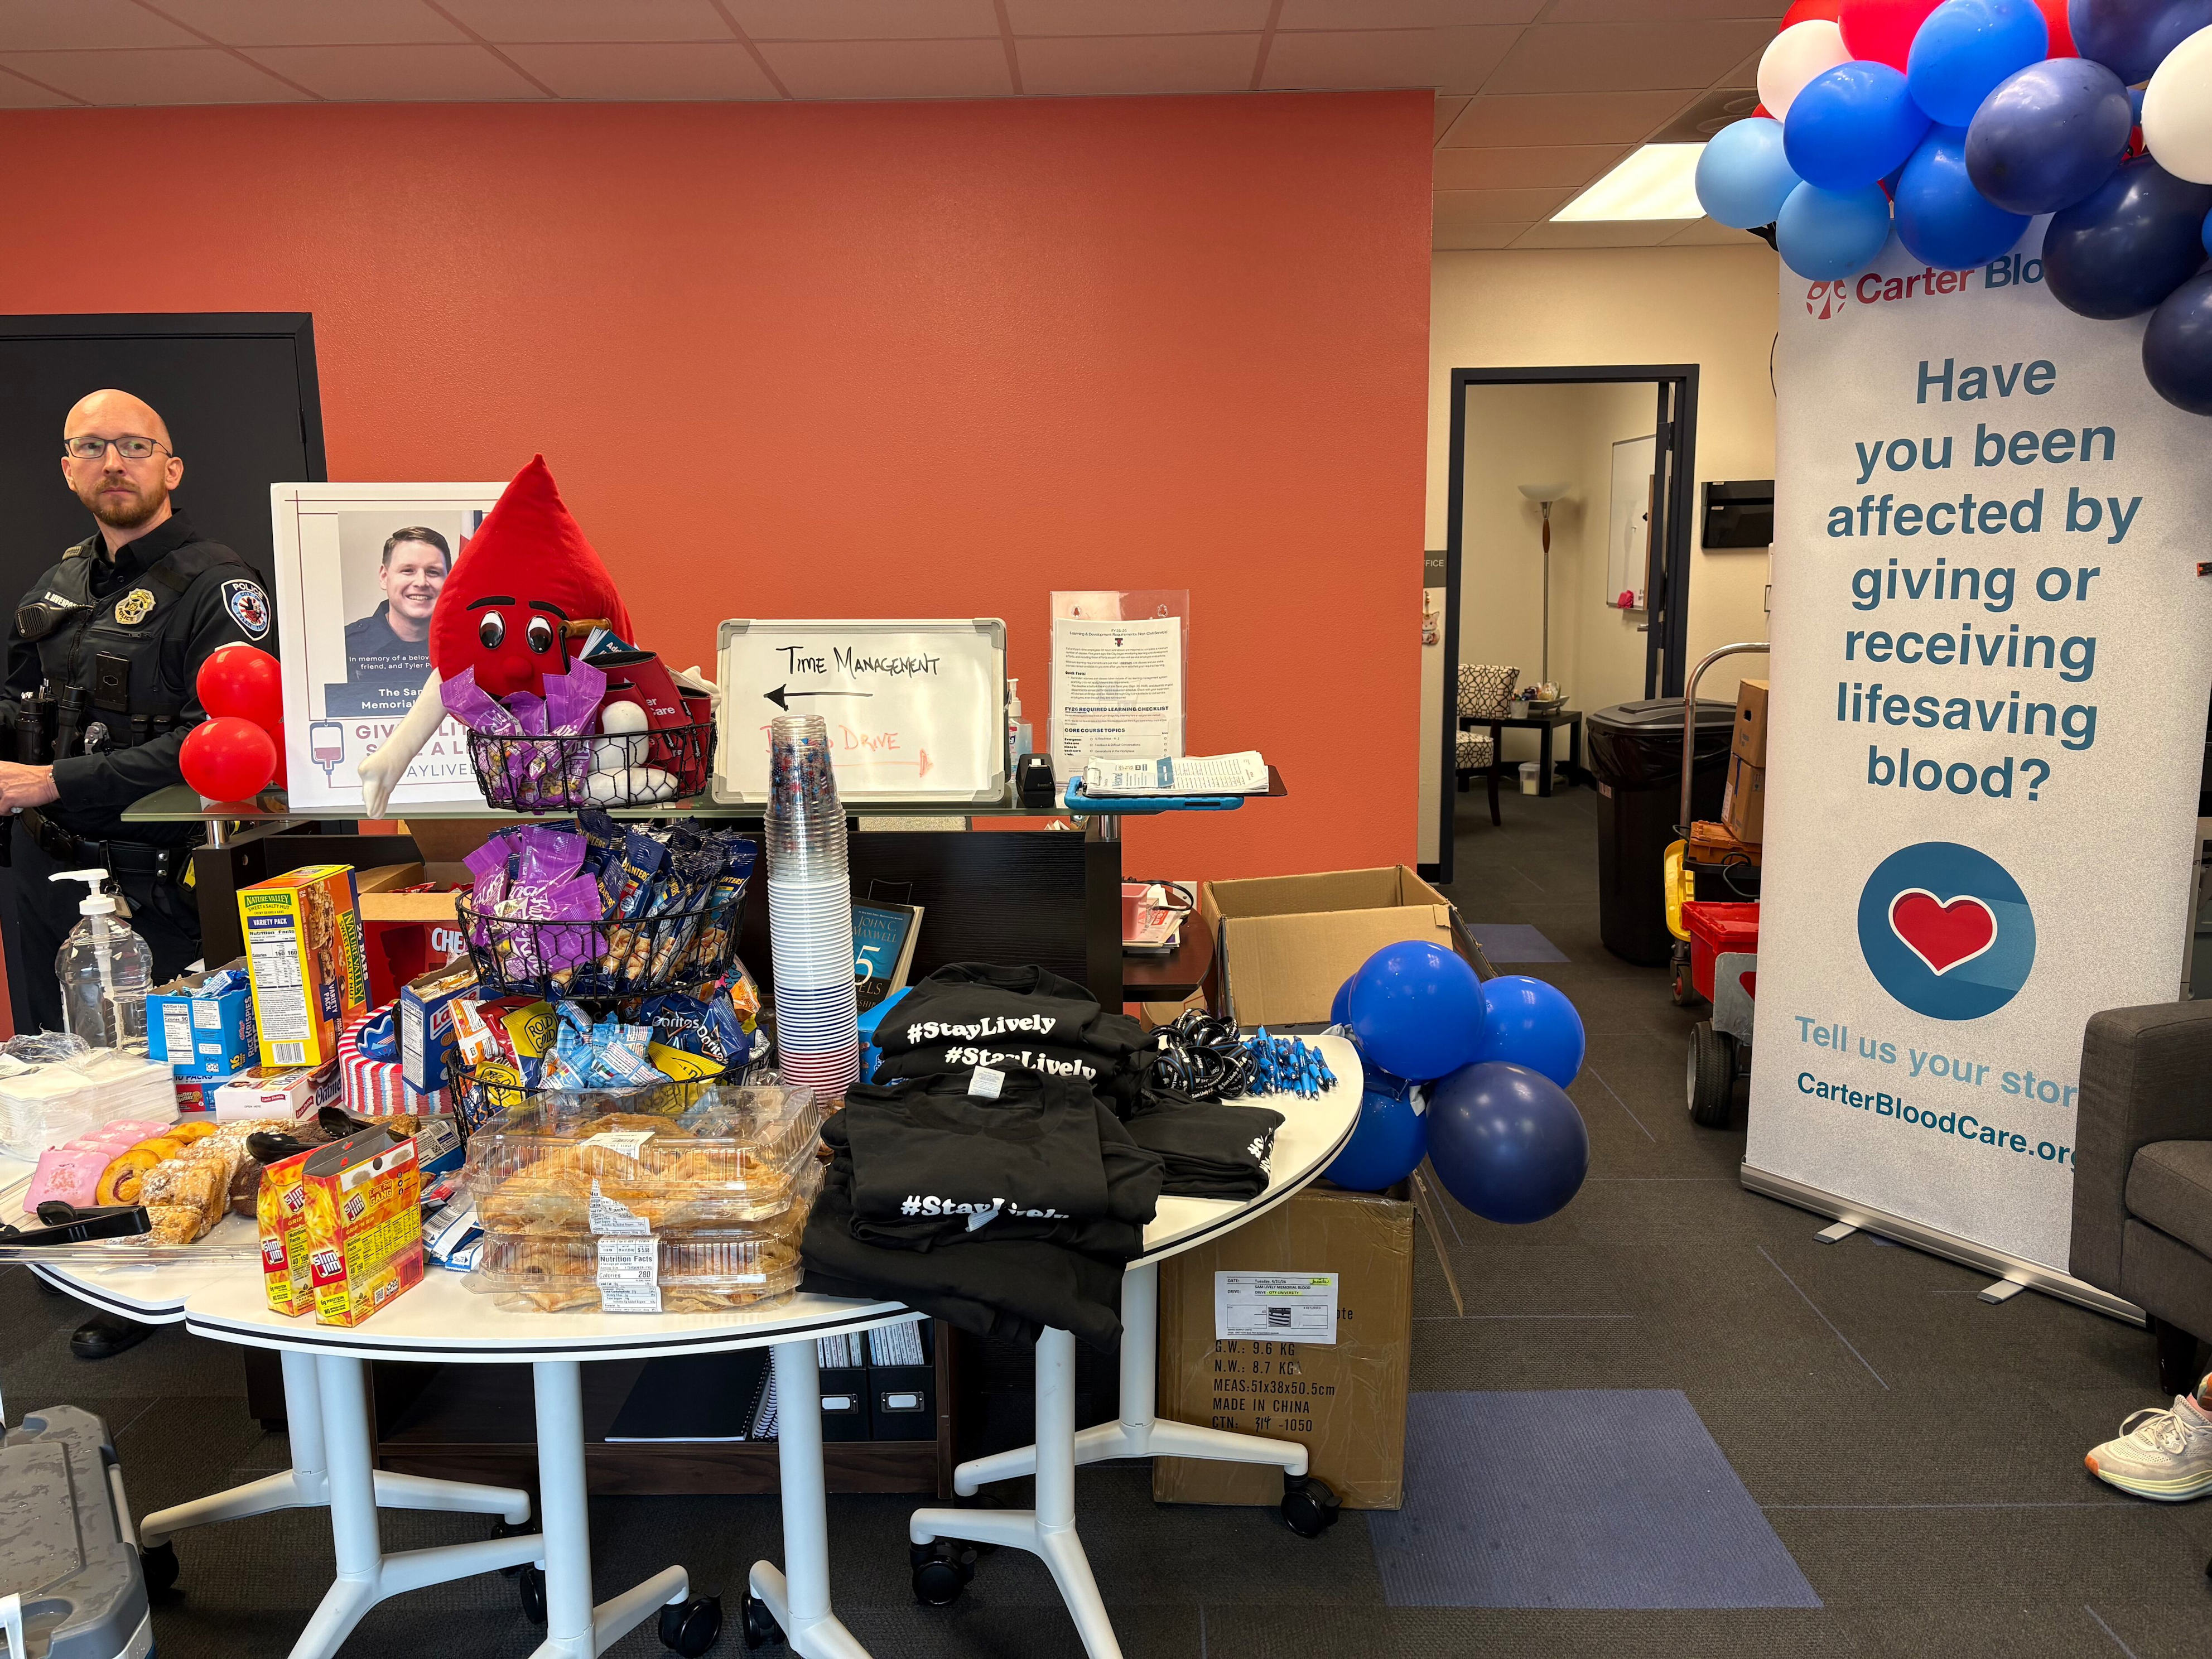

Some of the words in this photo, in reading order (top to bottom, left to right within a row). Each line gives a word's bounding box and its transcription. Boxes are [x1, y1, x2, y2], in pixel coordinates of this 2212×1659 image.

[1856, 267, 1975, 305] Carter
[1917, 358, 2057, 404] Have
[1855, 436, 1953, 484] you
[1974, 423, 2116, 466] been
[1827, 488, 2044, 537] affected
[2065, 487, 2143, 544] by
[232, 583, 263, 600] POLICE
[1852, 558, 2016, 613] giving
[2036, 565, 2100, 602] or
[1846, 623, 2096, 682] receiving
[1837, 682, 2097, 750] lifesaving
[431, 741, 445, 755] A
[1868, 745, 2051, 801] blood?
[621, 857, 649, 881] PLANTERS
[247, 895, 268, 906] NATURE
[268, 895, 288, 904] VALLEY
[599, 882, 616, 906] PLANTERS
[356, 923, 363, 940] 24
[858, 916, 885, 929] JOHN
[888, 921, 897, 931] C.
[339, 920, 349, 948] SWEET
[853, 926, 897, 942] MAXWELL
[344, 915, 358, 961] NATURE
[354, 960, 364, 998] VALLEY
[359, 946, 368, 981] BARS
[855, 945, 881, 986] 5
[323, 992, 332, 1011] PACK
[329, 983, 338, 1013] VARIETY
[244, 996, 253, 1038] KRISPIES
[652, 1015, 700, 1029] Doritos
[528, 1017, 553, 1037] ROLD
[907, 1014, 1056, 1044] #StayLively
[247, 1038, 255, 1057] RICE
[536, 1029, 555, 1049] GOLD
[697, 1025, 729, 1064] Doritos
[229, 1054, 240, 1069] 16
[1795, 1015, 1847, 1052] Tell
[1859, 1036, 1897, 1064] us
[1909, 1048, 1990, 1086] your
[2001, 1070, 2078, 1107] stor
[316, 1078, 341, 1106] Oatme
[344, 1195, 362, 1214] slim
[370, 1190, 392, 1207] GANG
[350, 1202, 365, 1221] jim
[288, 1217, 303, 1226] GRIP
[346, 1225, 358, 1234] GRIP
[366, 1217, 374, 1226] RIP
[264, 1240, 279, 1252] slim
[269, 1251, 283, 1263] jim
[313, 1252, 338, 1266] slim
[322, 1261, 341, 1276] jim
[327, 1295, 344, 1304] PROTEIN
[1215, 1340, 1245, 1353] G.W.:
[1253, 1342, 1273, 1355] 9.6
[1280, 1343, 1295, 1356] KG
[1215, 1359, 1245, 1373] N.W.:
[1252, 1362, 1270, 1374] 8.7
[1279, 1362, 1294, 1375] KG
[1213, 1398, 1246, 1410] MADE
[1253, 1399, 1265, 1411] IN
[1273, 1400, 1310, 1414] CHINA
[1212, 1416, 1238, 1429] CTN:
